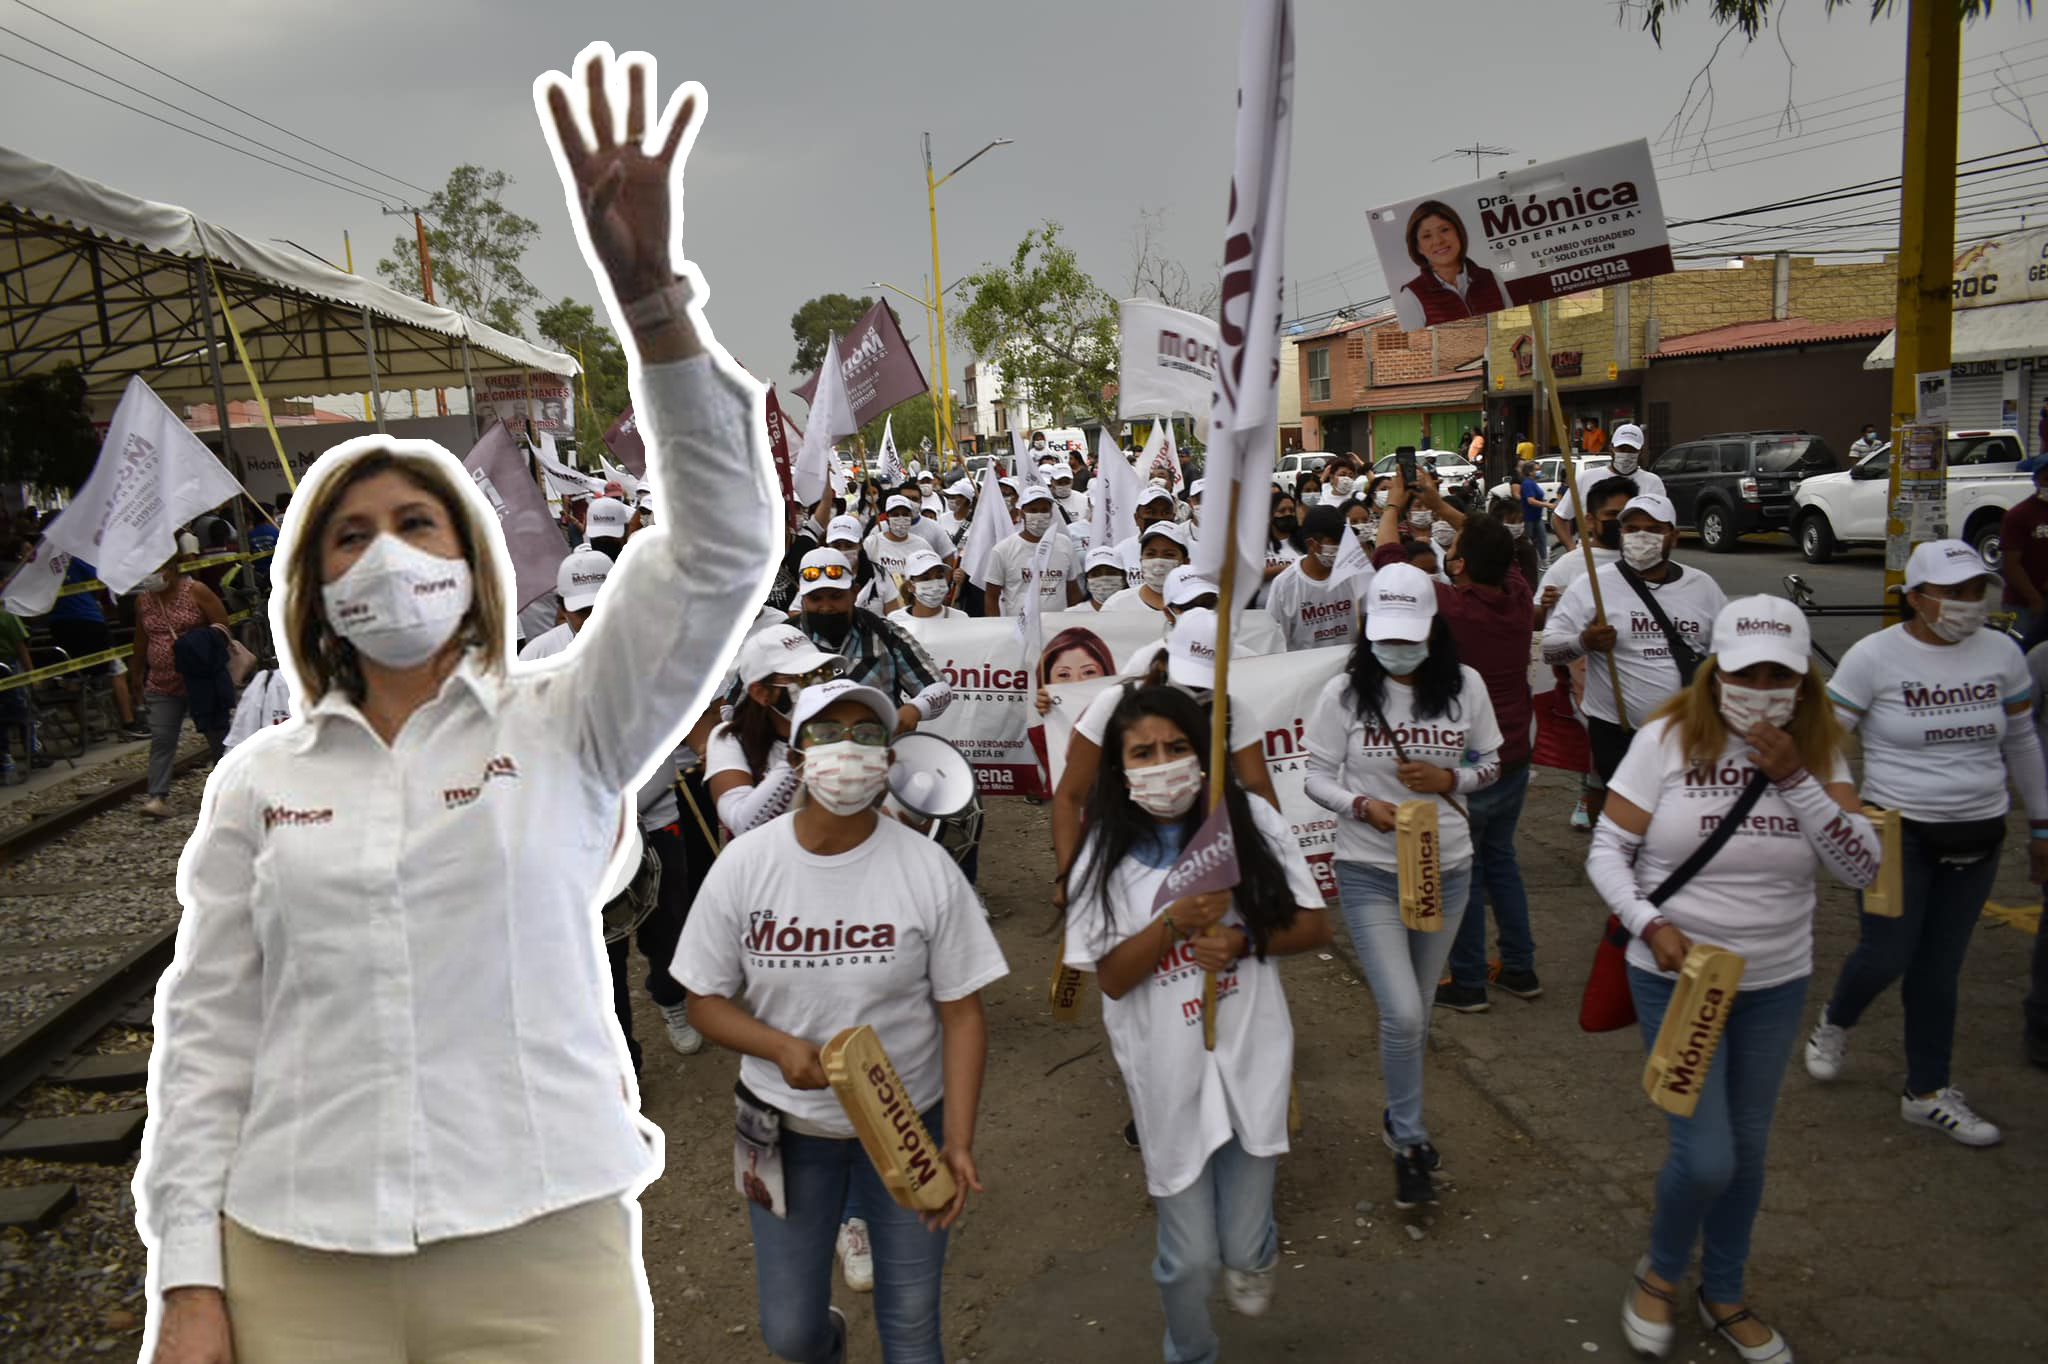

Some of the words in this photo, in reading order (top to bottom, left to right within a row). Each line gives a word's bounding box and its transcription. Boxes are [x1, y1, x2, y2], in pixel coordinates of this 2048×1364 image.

[1477, 194, 1513, 210] Dra.
[1480, 182, 1639, 238] Mónica
[1494, 210, 1637, 250] GOBERNADORA
[1531, 251, 1540, 259] EL
[1543, 241, 1579, 257] CAMBIO
[1580, 228, 1636, 246] VERDADERO
[1554, 251, 1577, 262] SOLO
[1579, 245, 1602, 258] ESTÁ
[1602, 242, 1615, 252] EN
[1551, 259, 1630, 287] morena
[1952, 274, 1998, 299] ROC
[1048, 440, 1082, 451] FedEx
[1301, 600, 1351, 621] Mónca
[1380, 593, 1416, 604] Mónica
[1631, 617, 1699, 633] Móica
[1735, 617, 1792, 634] Mónica
[941, 659, 1028, 690] ónica
[951, 693, 1024, 702] RNADORA
[1904, 682, 1997, 708] Mónica
[1363, 722, 1464, 747] Mónica
[1925, 723, 1997, 742] morena
[973, 768, 1013, 783] rena
[1685, 759, 1757, 786] Món
[1700, 815, 1801, 832] mrena
[1418, 831, 1436, 918] Mónica
[745, 916, 896, 952] Mónica
[1060, 968, 1081, 1009] nica
[1668, 987, 1724, 1095] Mónica
[868, 1063, 938, 1187] Mónica
